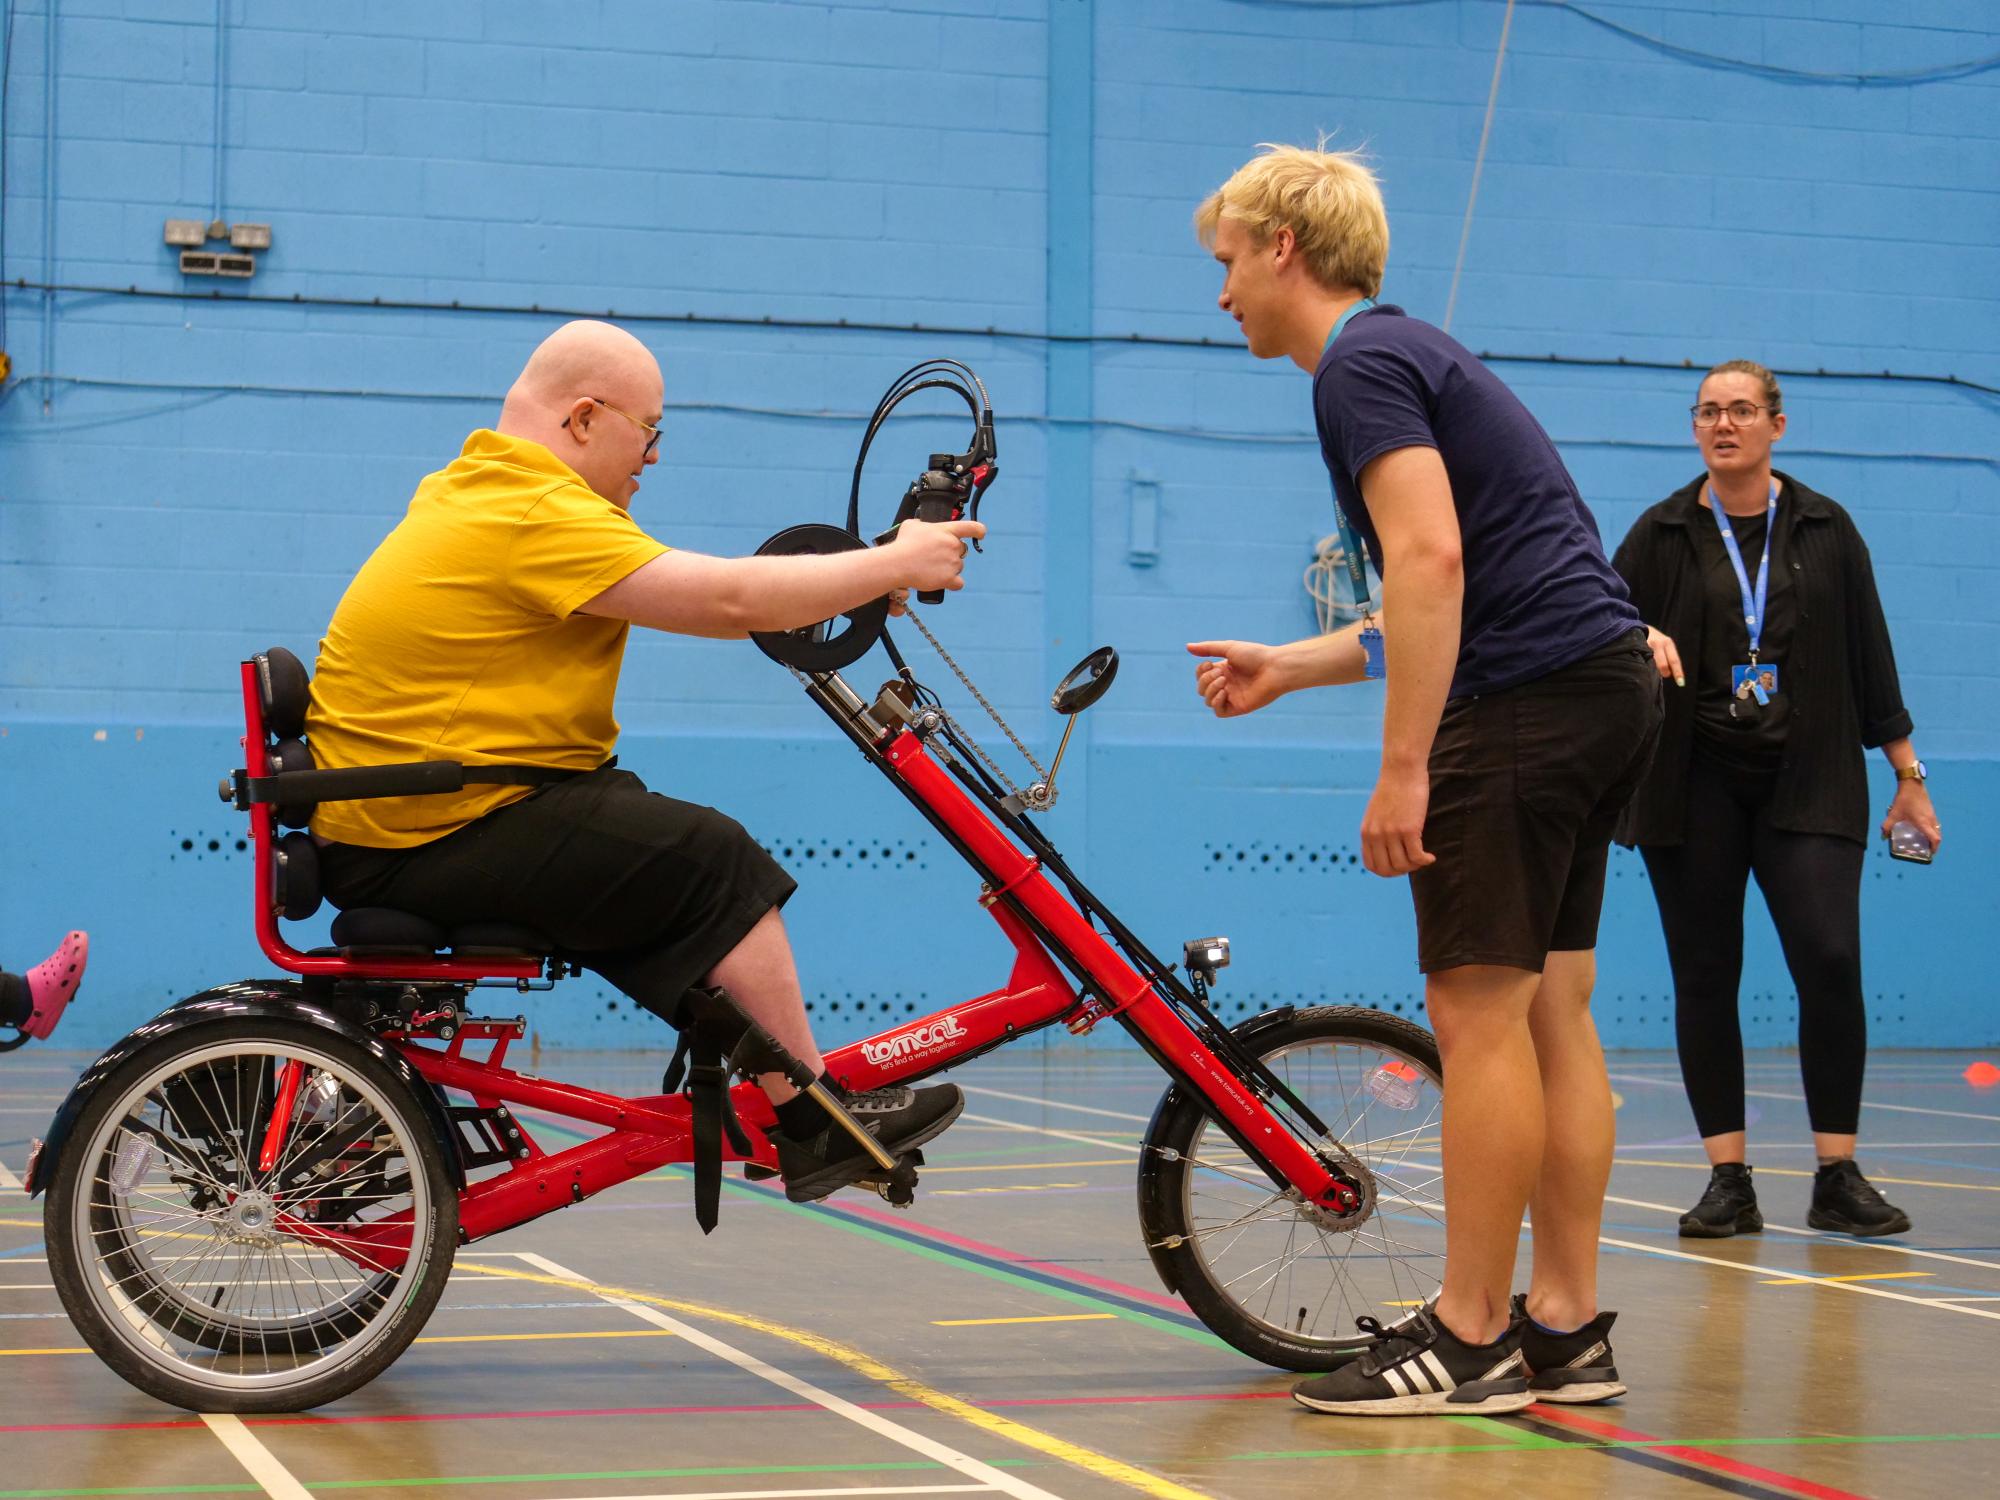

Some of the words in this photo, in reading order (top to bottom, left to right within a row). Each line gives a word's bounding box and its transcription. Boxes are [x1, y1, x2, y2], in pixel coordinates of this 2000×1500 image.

[861, 1015, 967, 1065] tomcat
[880, 1061, 894, 1071] let's
[895, 1055, 908, 1066] find
[914, 1050, 928, 1060] way
[1211, 1071, 1254, 1115] www.tomcatuk.org
[392, 1307, 408, 1329] ROAD
